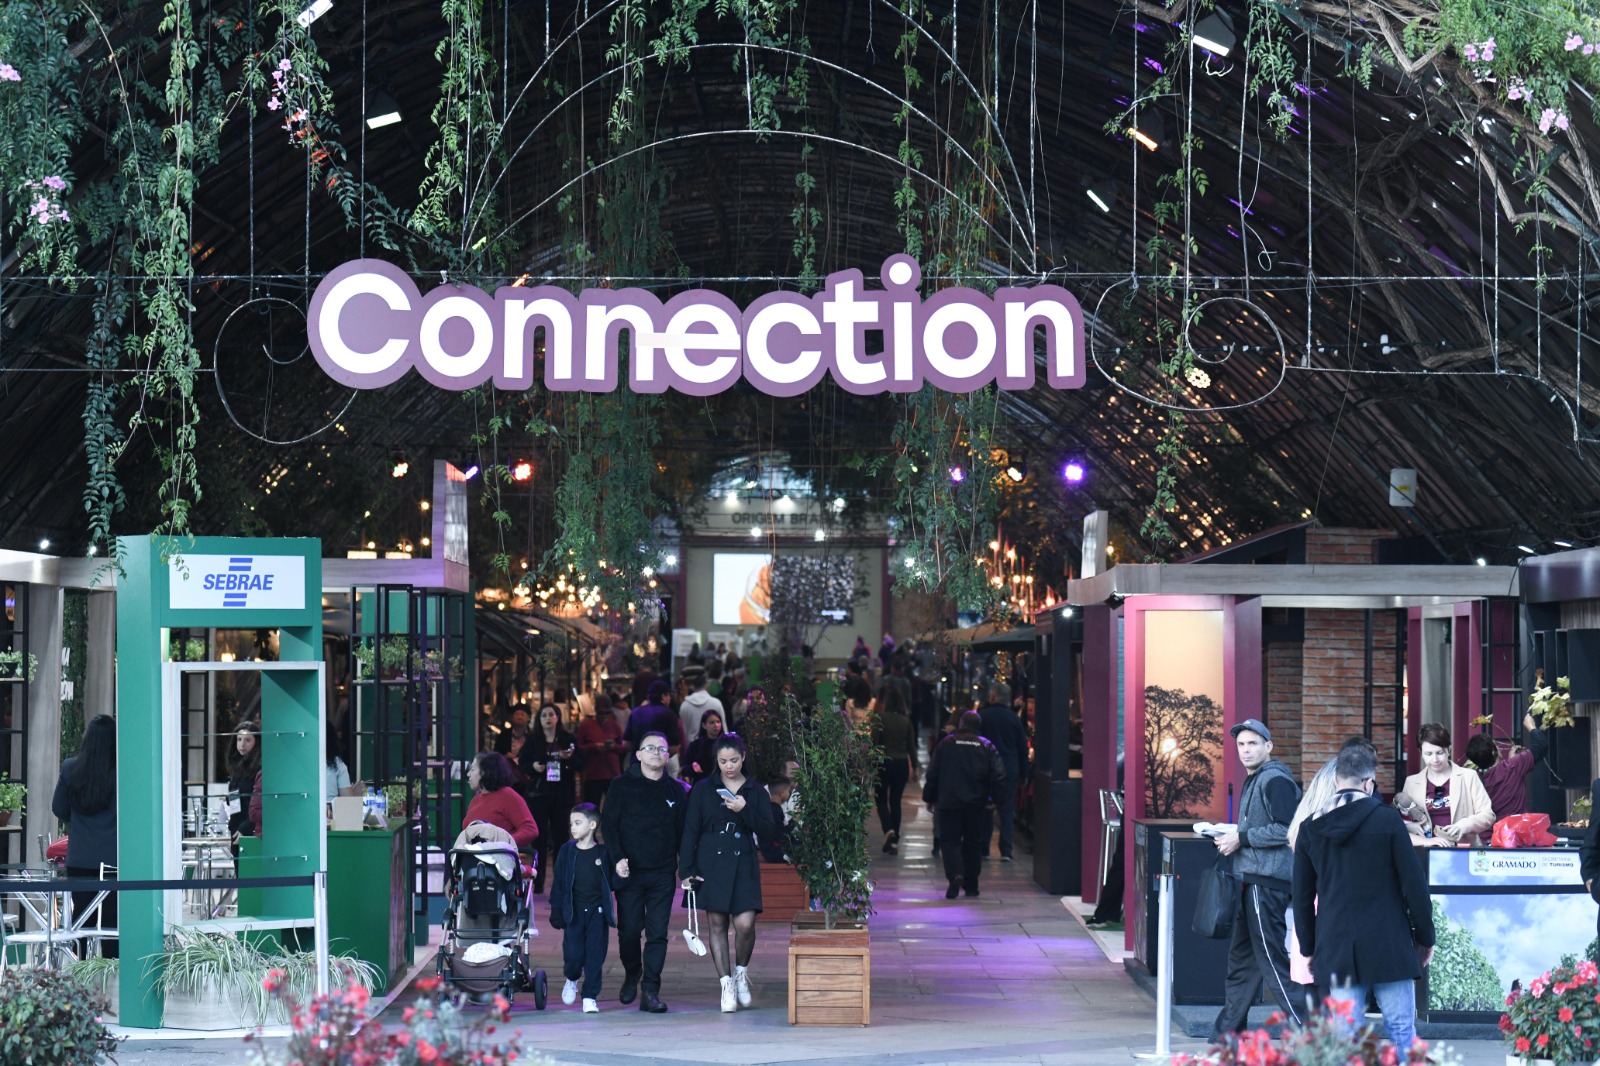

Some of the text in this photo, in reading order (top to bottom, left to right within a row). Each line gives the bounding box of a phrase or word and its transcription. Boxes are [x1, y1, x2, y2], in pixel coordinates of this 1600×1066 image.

[318, 261, 1074, 384] Connection
[731, 512, 785, 525] ORIGEM
[203, 573, 274, 591] SEBRAE
[1492, 860, 1537, 869] GRAMADO
